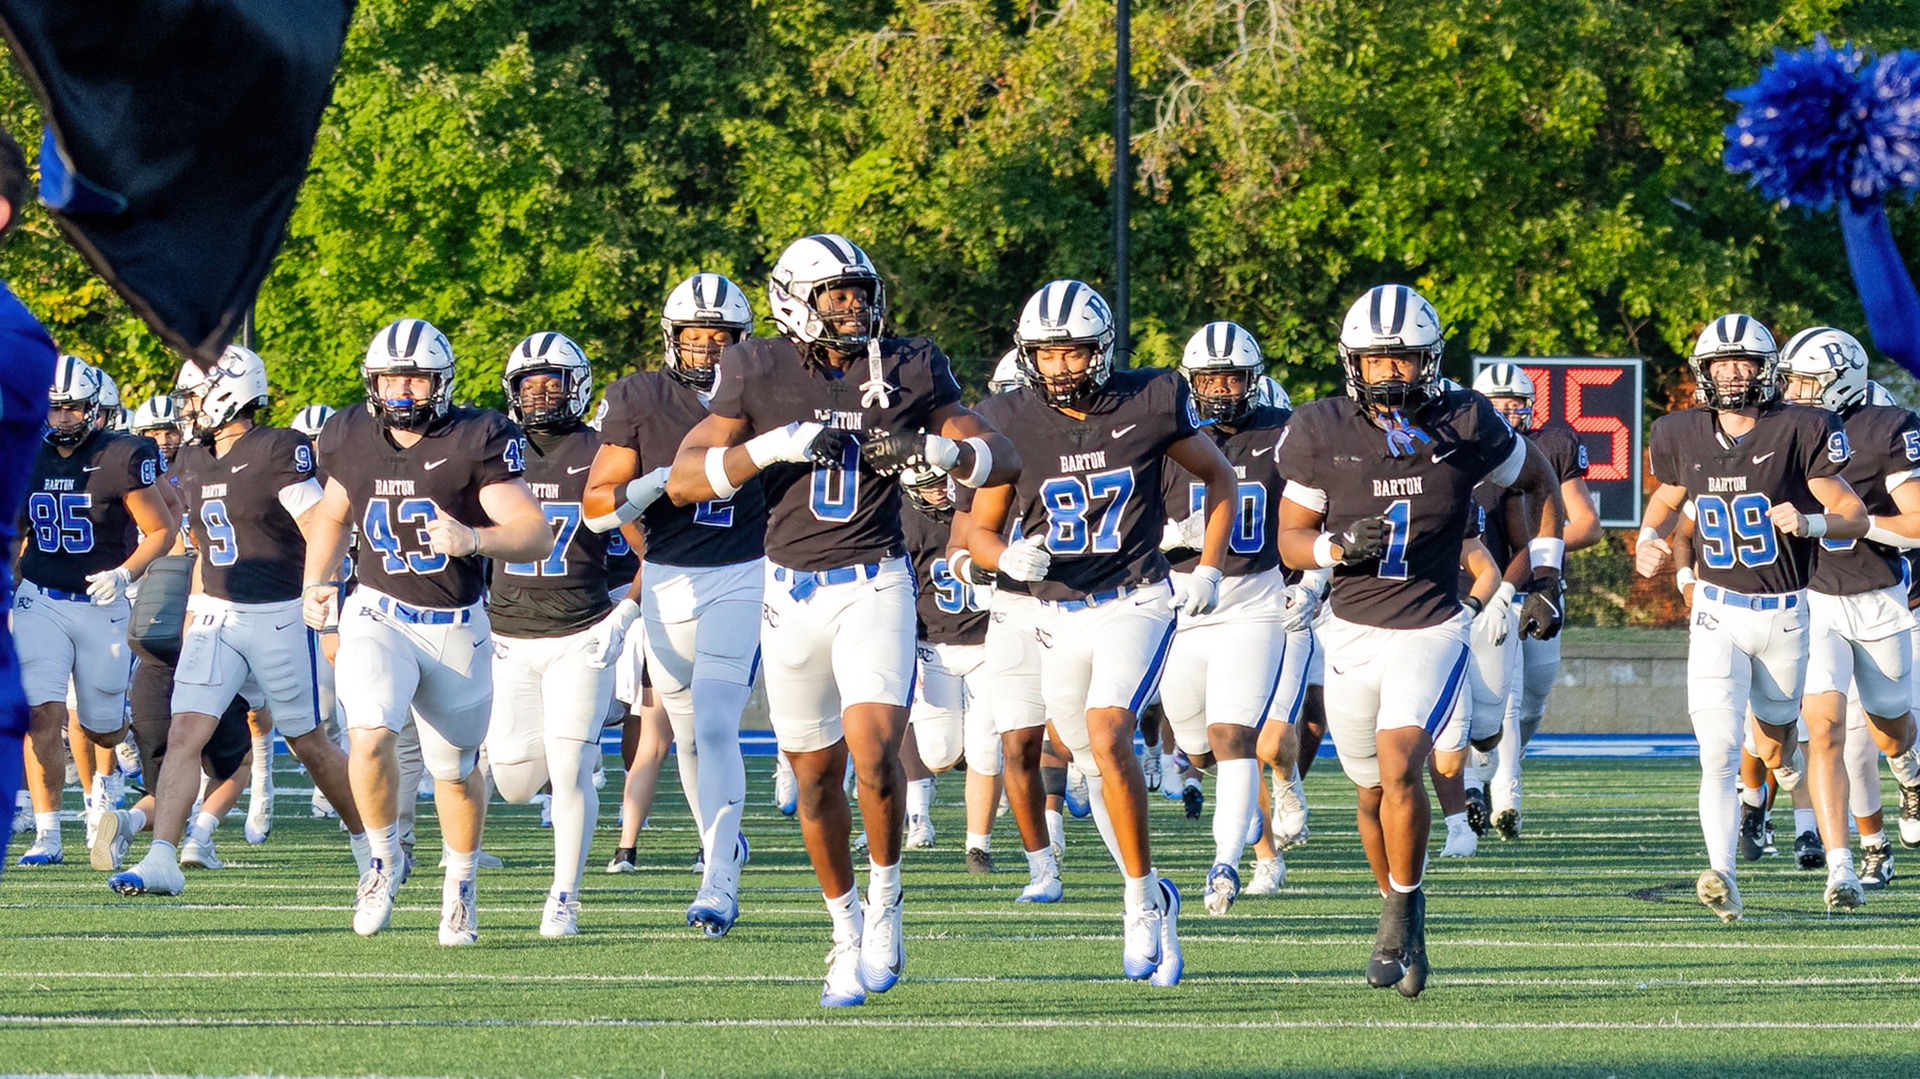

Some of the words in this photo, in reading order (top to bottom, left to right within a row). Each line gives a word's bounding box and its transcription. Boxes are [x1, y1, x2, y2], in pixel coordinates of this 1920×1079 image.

[295, 445, 312, 472] 9
[1059, 451, 1107, 473] BARTON
[1828, 430, 1850, 463] 9
[44, 478, 74, 491] BARTON
[375, 479, 415, 496] BARTON
[1371, 476, 1424, 497] BARTON
[1708, 477, 1747, 492] BARTON
[29, 492, 94, 554] 85
[1039, 466, 1135, 554] 87
[200, 499, 239, 566] 9
[363, 497, 449, 575] 43
[1377, 499, 1412, 580] 1
[1695, 492, 1778, 569] 99
